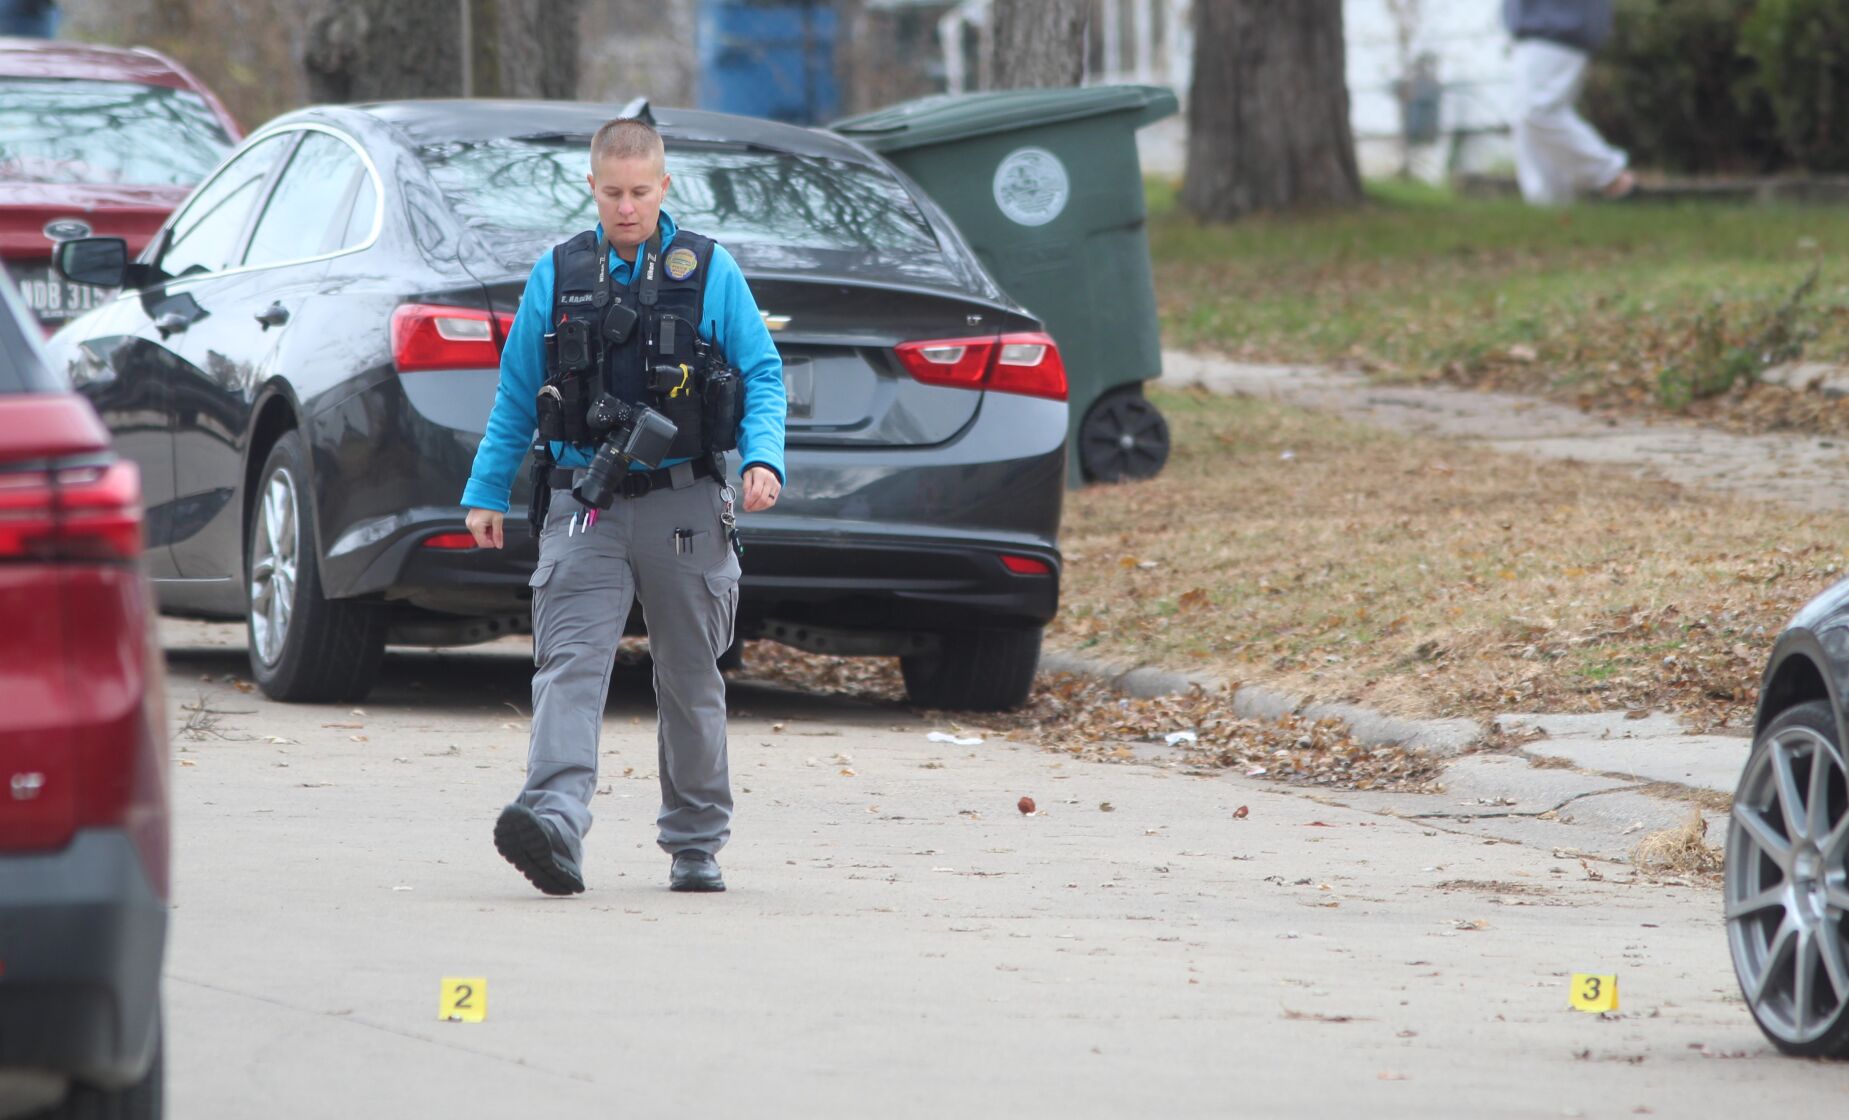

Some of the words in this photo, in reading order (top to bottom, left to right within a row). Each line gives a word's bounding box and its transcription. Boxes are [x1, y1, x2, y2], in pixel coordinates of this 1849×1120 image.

[647, 252, 657, 262] Z
[454, 984, 472, 1008] 2
[1583, 977, 1601, 1001] 3
